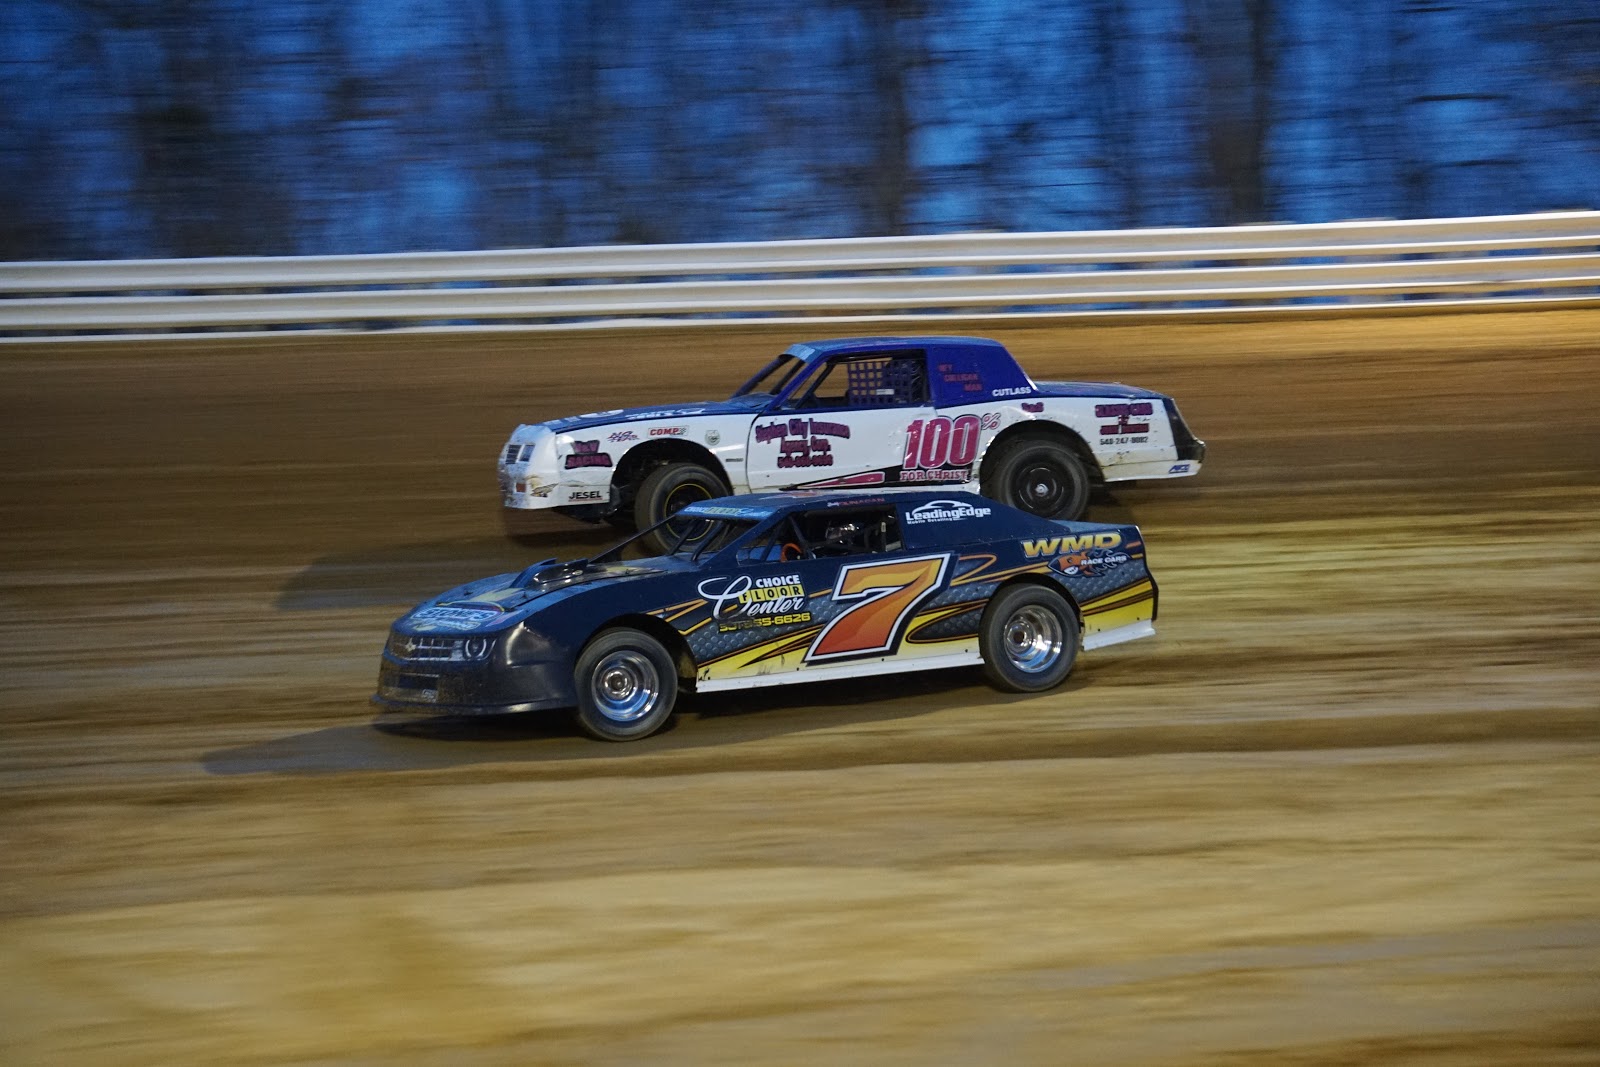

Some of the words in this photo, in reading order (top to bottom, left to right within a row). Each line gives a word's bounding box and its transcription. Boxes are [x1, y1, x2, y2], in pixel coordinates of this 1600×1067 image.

[992, 386, 1032, 397] CUTLASS
[650, 427, 680, 436] COMP
[900, 471, 924, 481] FOR
[927, 469, 968, 481] CHRIST
[569, 490, 602, 500] JESEL
[905, 507, 991, 521] LeadingEdge
[1021, 532, 1122, 558] WMD
[1081, 558, 1103, 566] RACE
[1104, 555, 1127, 563] CARS
[756, 575, 800, 588] CHOICE
[698, 575, 804, 619] Center
[741, 585, 802, 602] FLOOR
[802, 552, 952, 662] 7
